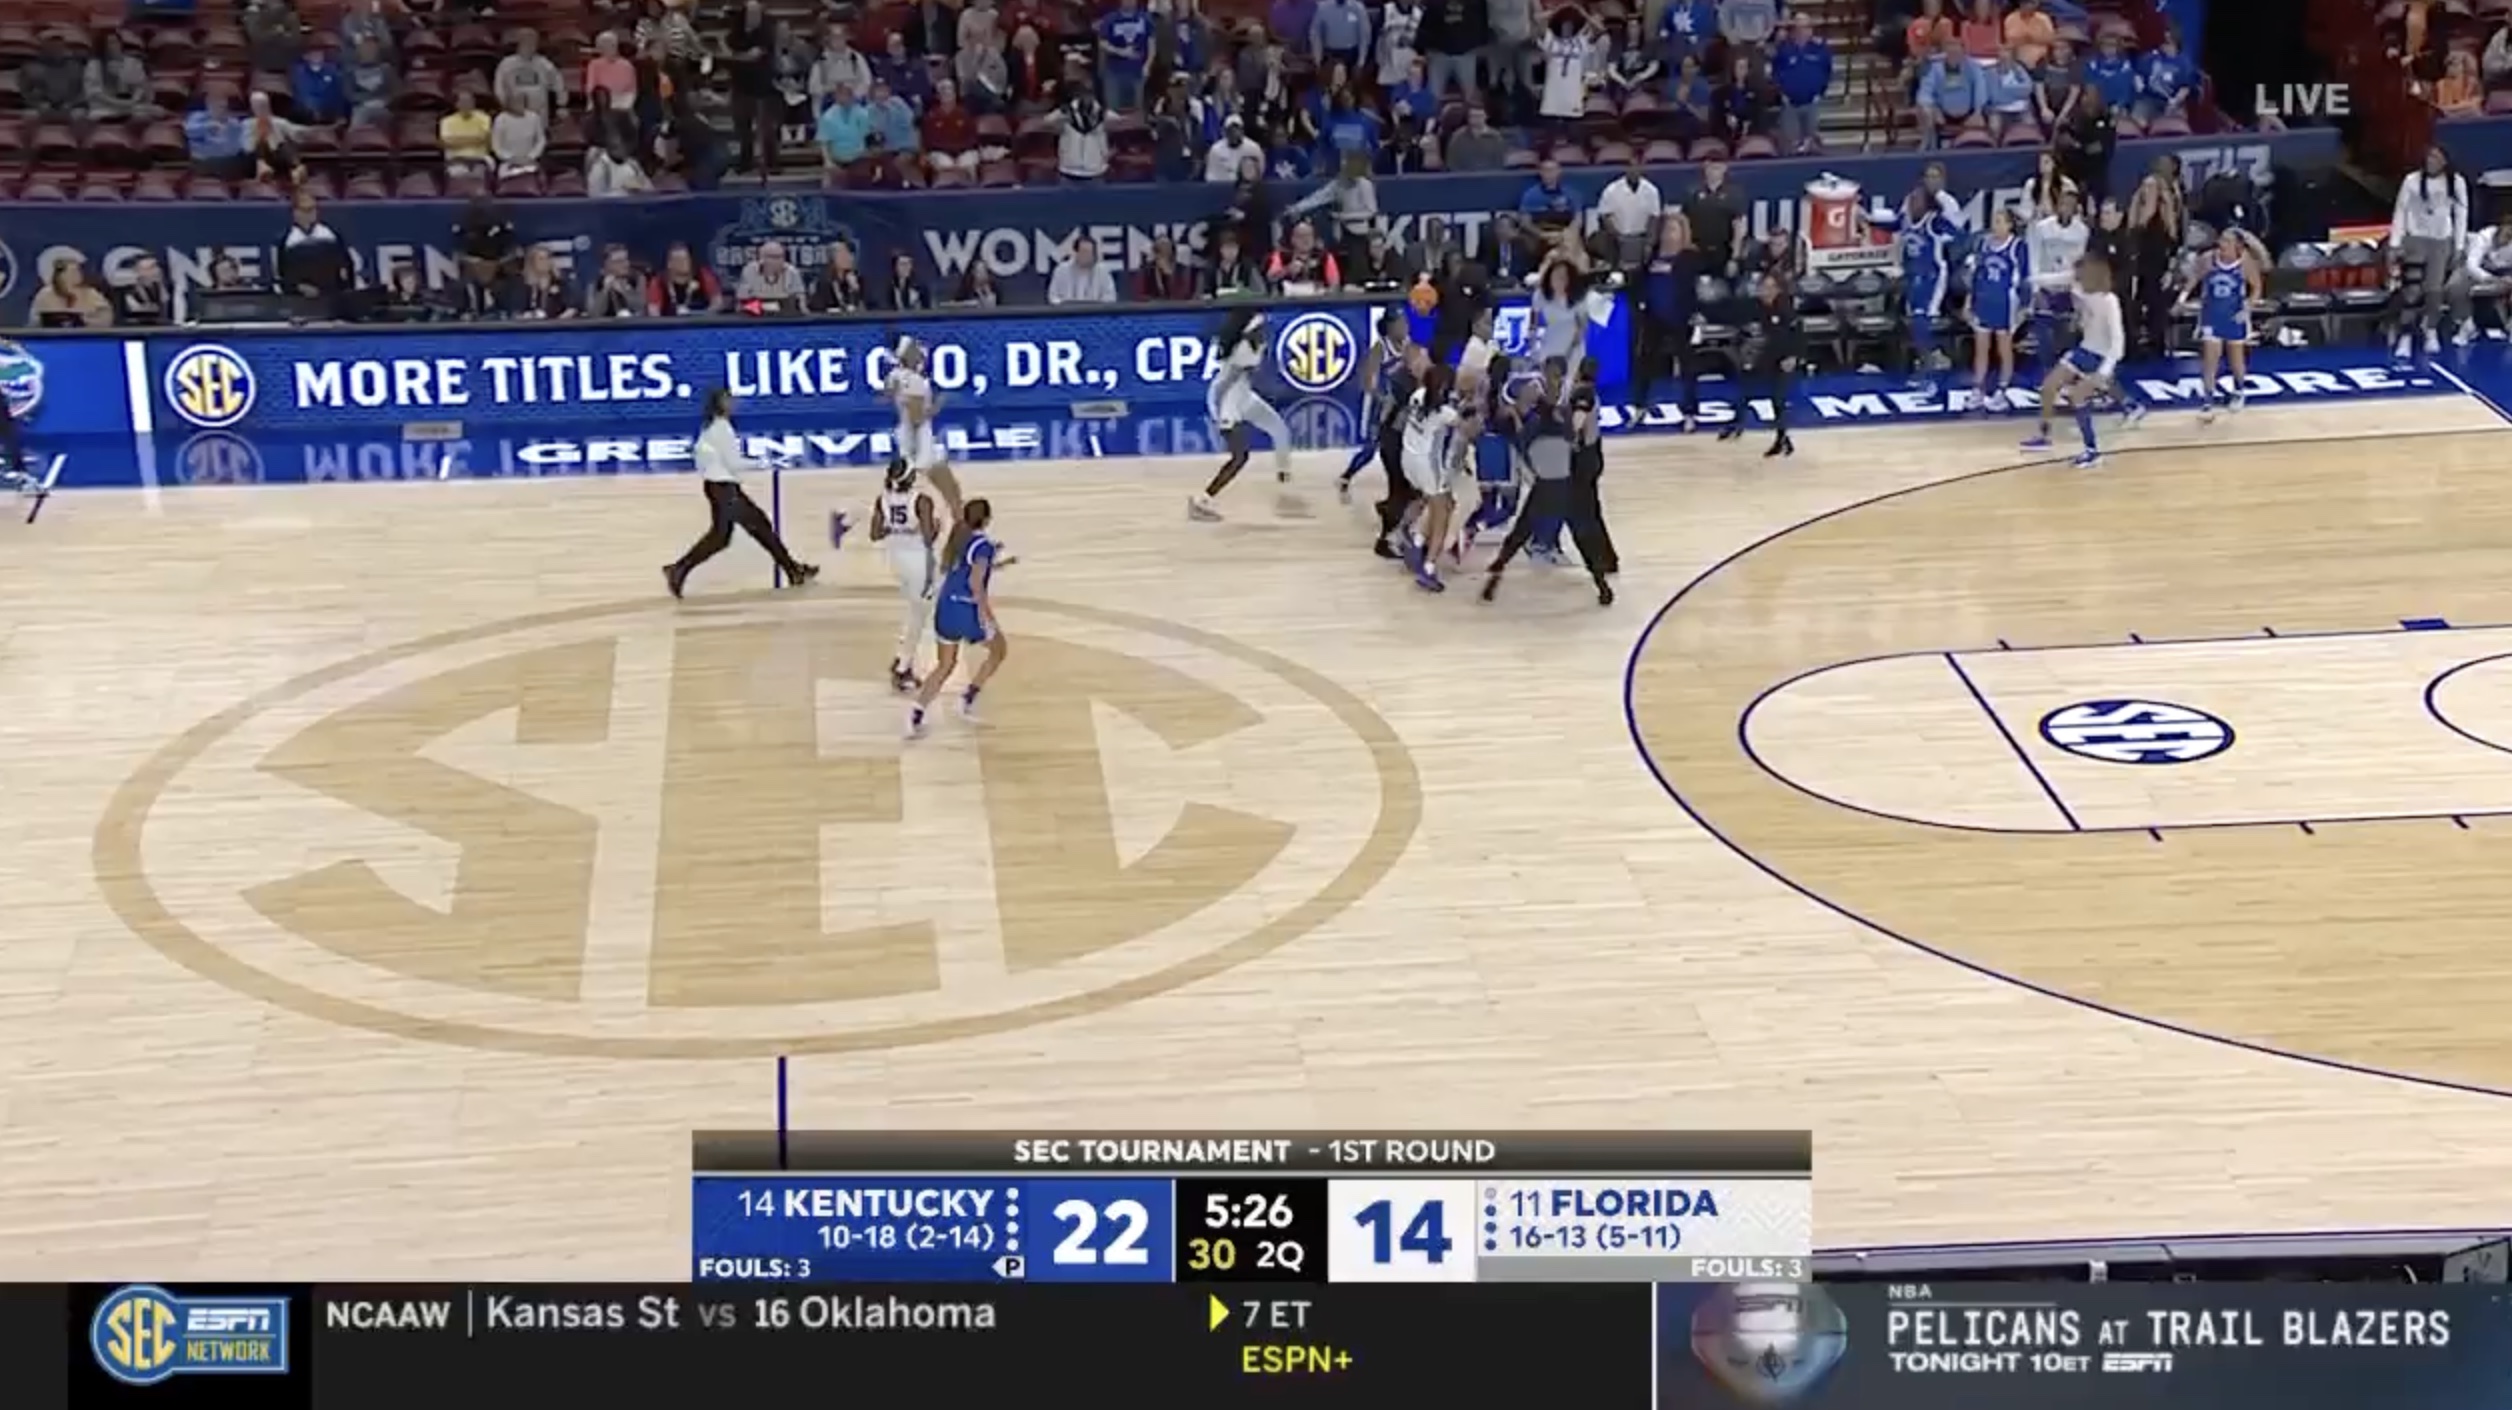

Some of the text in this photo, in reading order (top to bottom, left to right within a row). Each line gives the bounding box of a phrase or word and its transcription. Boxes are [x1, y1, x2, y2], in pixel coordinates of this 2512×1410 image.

[1827, 206, 1847, 229] G
[296, 359, 469, 409] MORE
[482, 351, 692, 402] TITLES.
[726, 347, 849, 397] LIKE
[865, 344, 987, 397] CO,
[1006, 341, 1118, 391] DR.,
[1286, 320, 1347, 384] SEC
[175, 353, 246, 418] SEC
[517, 427, 1039, 465] GRENVILE
[889, 504, 908, 525] 15
[237, 618, 1298, 1006] SEC
